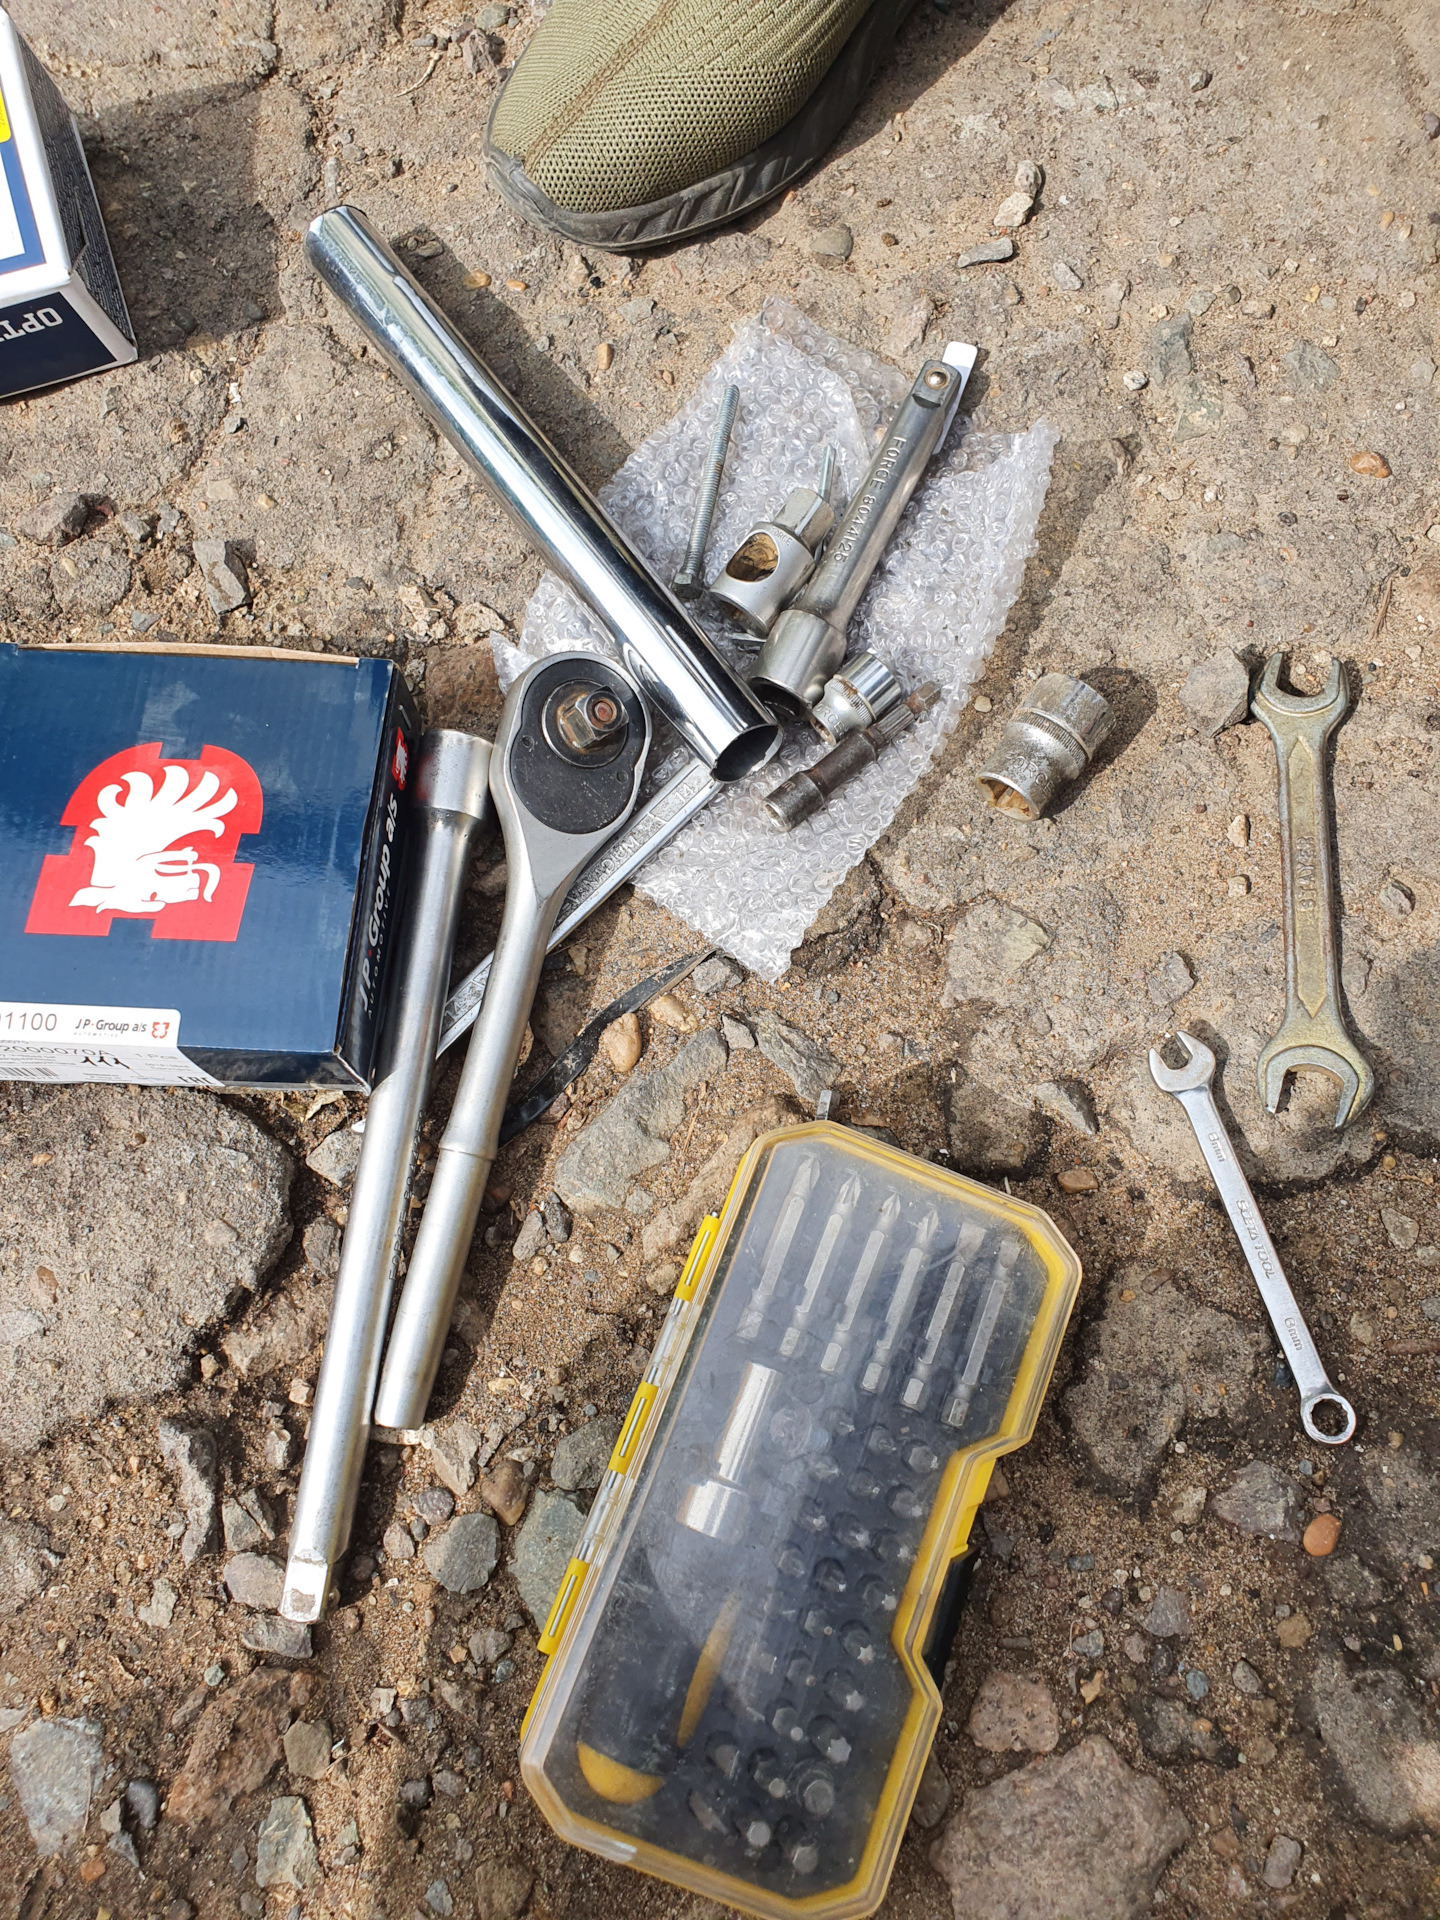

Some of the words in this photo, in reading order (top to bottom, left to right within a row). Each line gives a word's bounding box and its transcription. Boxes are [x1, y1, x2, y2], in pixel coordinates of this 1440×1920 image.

[0, 307, 64, 343] OPT
[869, 436, 907, 490] FORCE
[833, 494, 876, 563] 8044125
[816, 703, 845, 733] ORCE
[386, 792, 398, 842] a/s
[1296, 834, 1318, 912] STAYER
[0, 1012, 58, 1031] 1100
